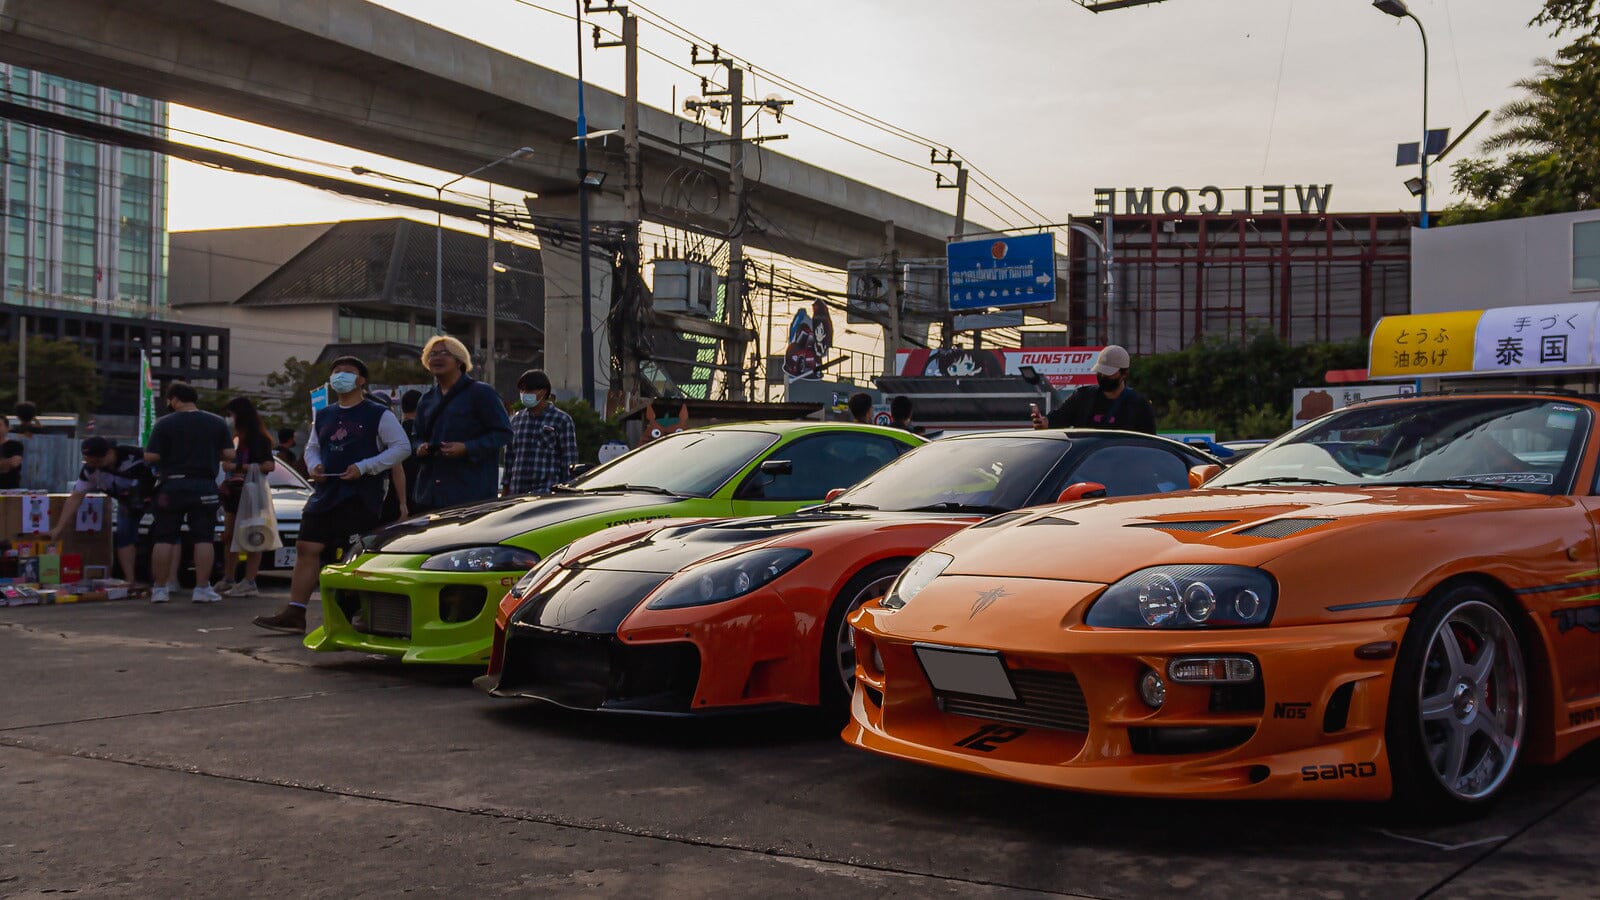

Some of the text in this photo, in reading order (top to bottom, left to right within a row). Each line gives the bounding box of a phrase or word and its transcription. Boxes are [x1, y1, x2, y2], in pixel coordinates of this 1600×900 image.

[1396, 328, 1450, 345] とうふ
[1021, 353, 1093, 365] RUNSTOP
[1393, 348, 1449, 368] 油あげ
[1495, 334, 1569, 366] 泰国
[952, 724, 1027, 752] 12
